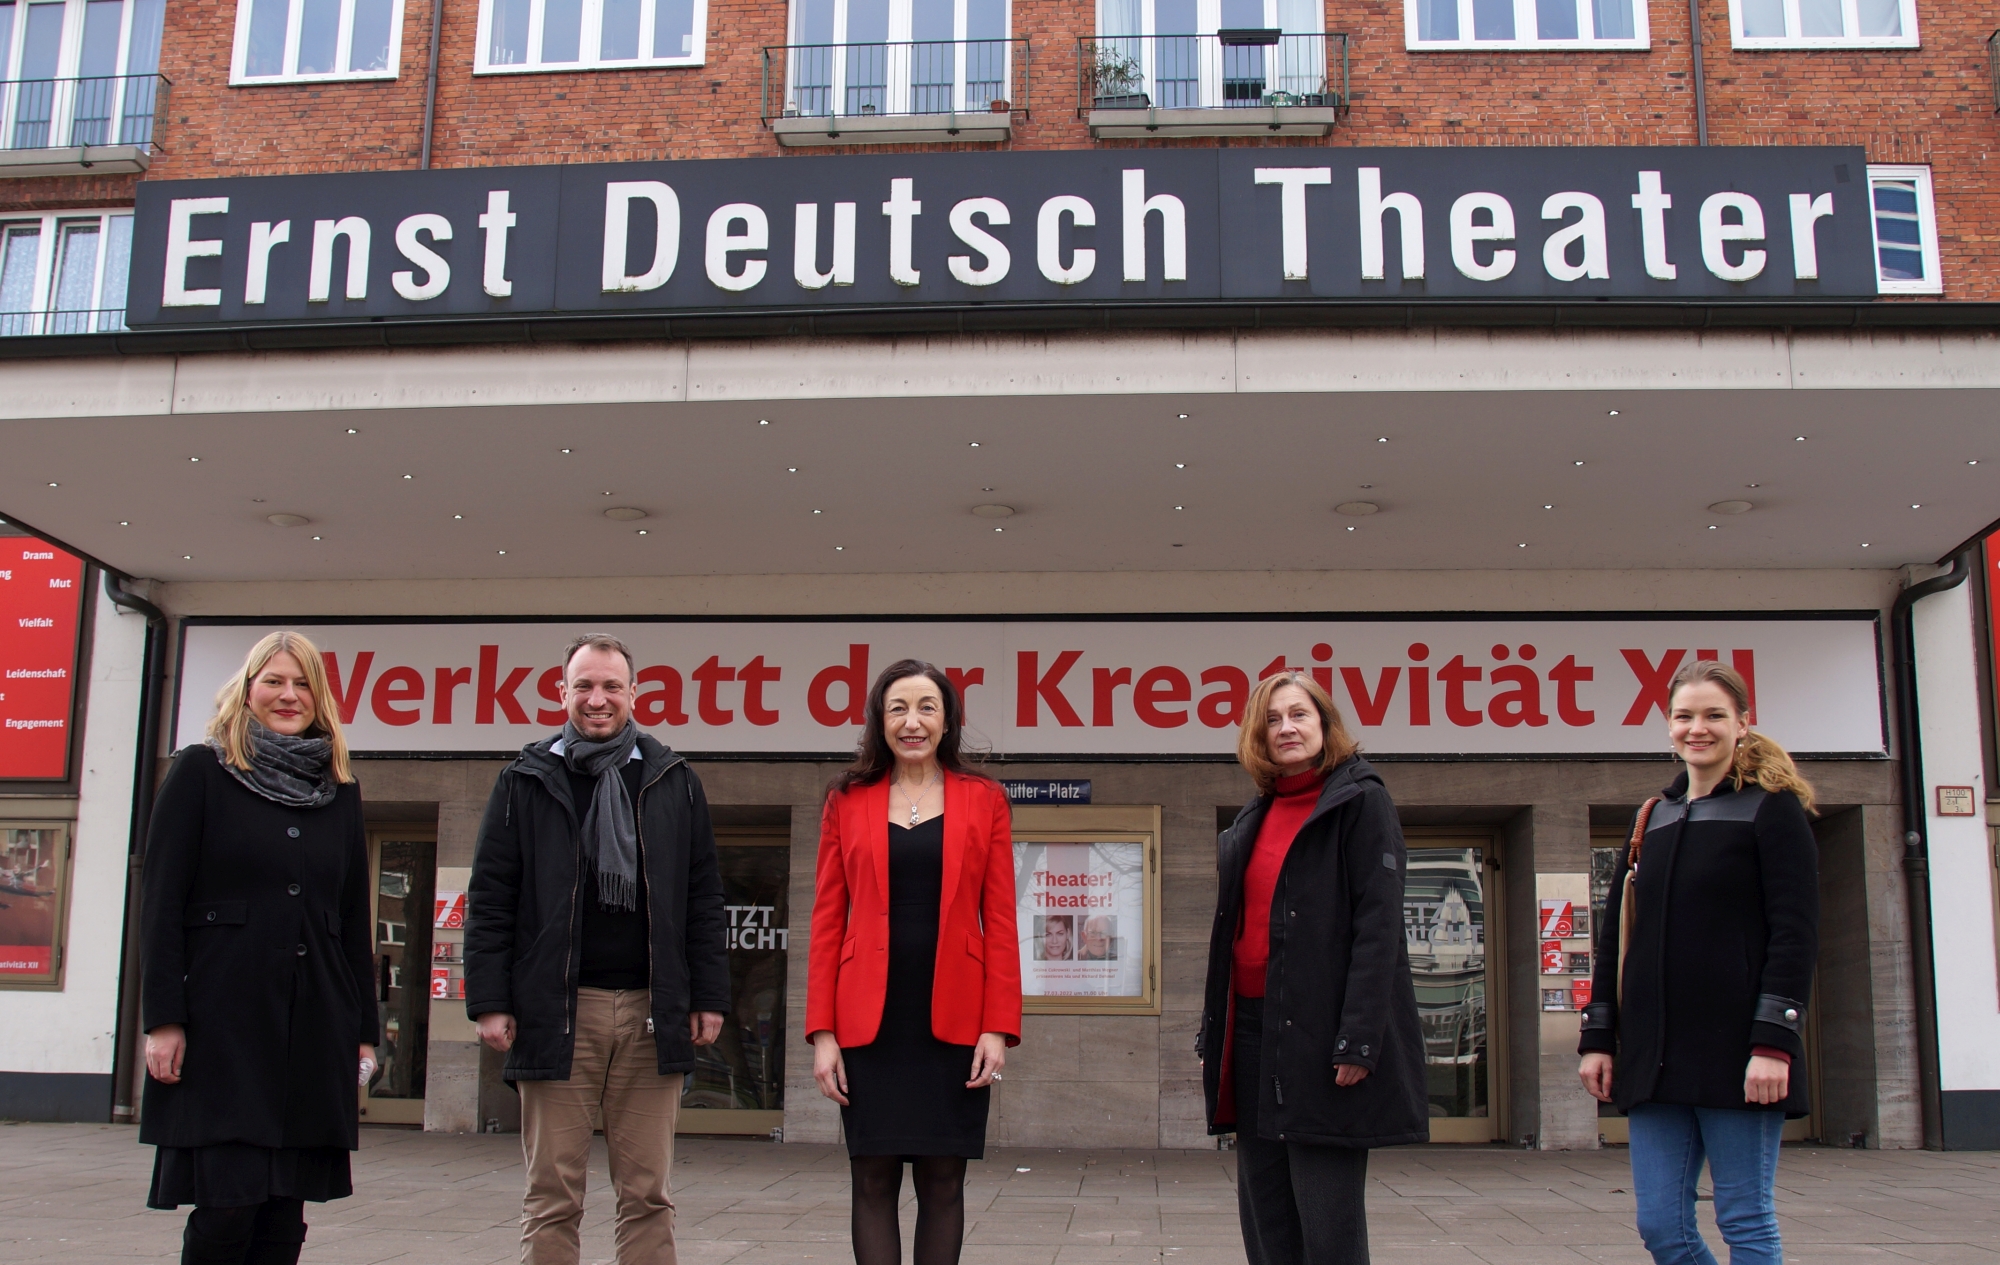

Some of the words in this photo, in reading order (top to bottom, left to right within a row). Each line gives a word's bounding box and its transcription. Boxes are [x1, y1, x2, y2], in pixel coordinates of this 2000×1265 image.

[162, 189, 516, 308] Ernst
[602, 168, 1187, 293] Deutsch
[1254, 166, 1834, 282] Theater
[22, 551, 54, 560] Drama
[49, 578, 72, 588] Mut
[19, 618, 53, 628] Vielfalt
[6, 669, 66, 679] Leidenschaft
[807, 644, 985, 728] dr
[5, 719, 64, 730] Engagement
[1033, 871, 1113, 887] Theater!
[1033, 892, 1113, 908] Theater!
[724, 905, 775, 927] TZT
